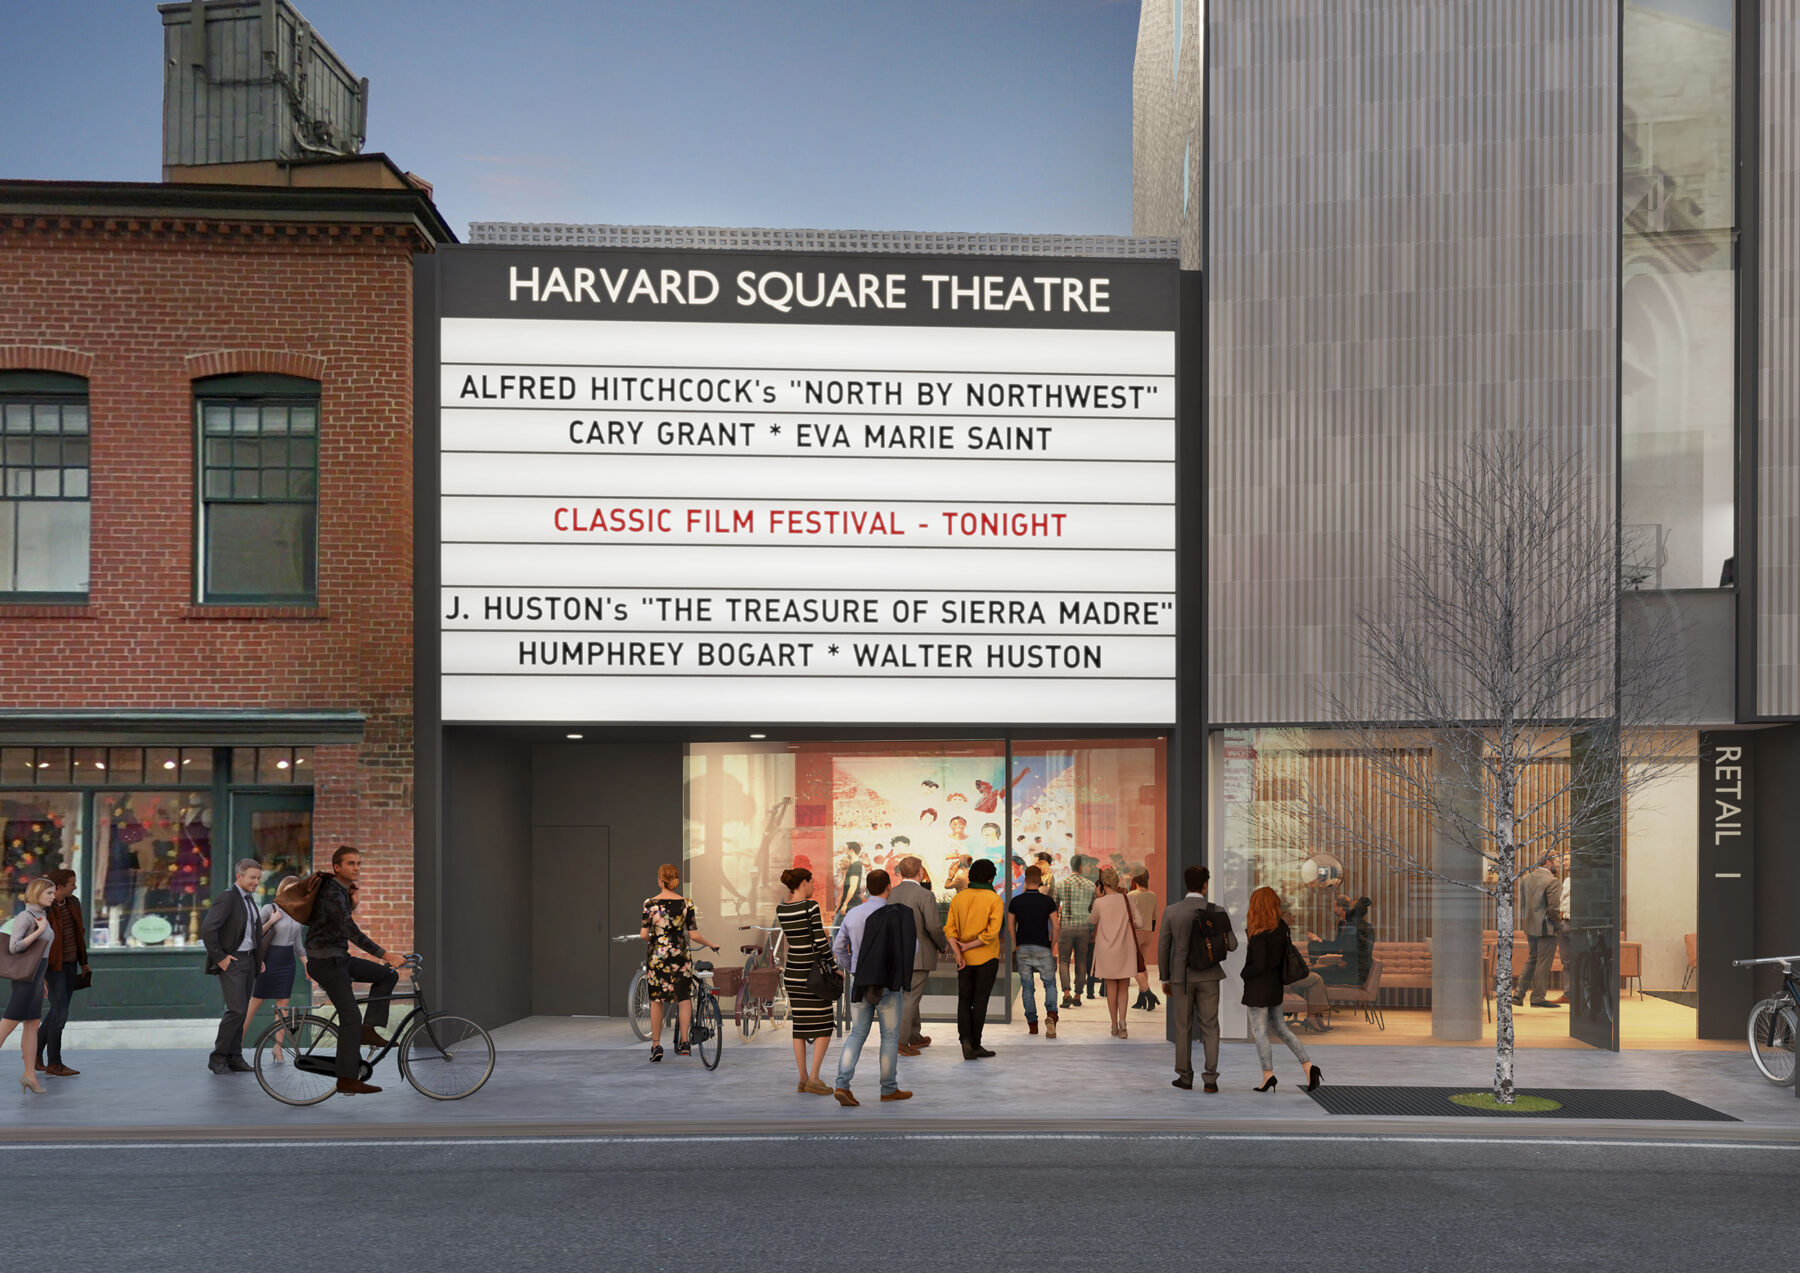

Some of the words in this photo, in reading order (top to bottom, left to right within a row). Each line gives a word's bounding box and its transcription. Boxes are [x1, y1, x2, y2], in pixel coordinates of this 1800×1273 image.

[510, 266, 719, 304] HARVARD
[737, 271, 906, 312] SQUARE
[922, 275, 1110, 312] THEATRE
[460, 375, 575, 400] ALFRED
[592, 377, 776, 403] HITCHCOCK's
[791, 380, 901, 405] "NORTH
[918, 383, 952, 406] BY
[967, 383, 1157, 409] NORTHWEST"
[570, 420, 643, 444] CARY
[658, 422, 755, 446] GRANT
[797, 424, 850, 447] EVA
[865, 425, 954, 449] MARIE
[968, 426, 1052, 450] SAINT
[555, 508, 671, 532] CLASSIC
[688, 509, 753, 533] FILM
[770, 510, 904, 535] FESTIVAL
[942, 512, 1067, 536] TONIGHT
[445, 596, 469, 619] J.
[485, 596, 627, 621] HUSTON's
[643, 598, 711, 621] "THE
[726, 598, 878, 622] TREASURE
[893, 600, 928, 623] OF
[942, 600, 1045, 624] SIERRA
[1060, 601, 1172, 625] MADRE"
[520, 641, 683, 665] HUMPHREY
[699, 643, 813, 666] BOGART
[853, 644, 972, 667] WALTER
[988, 645, 1101, 668] HUSTON
[1715, 747, 1742, 846] RETAIL
